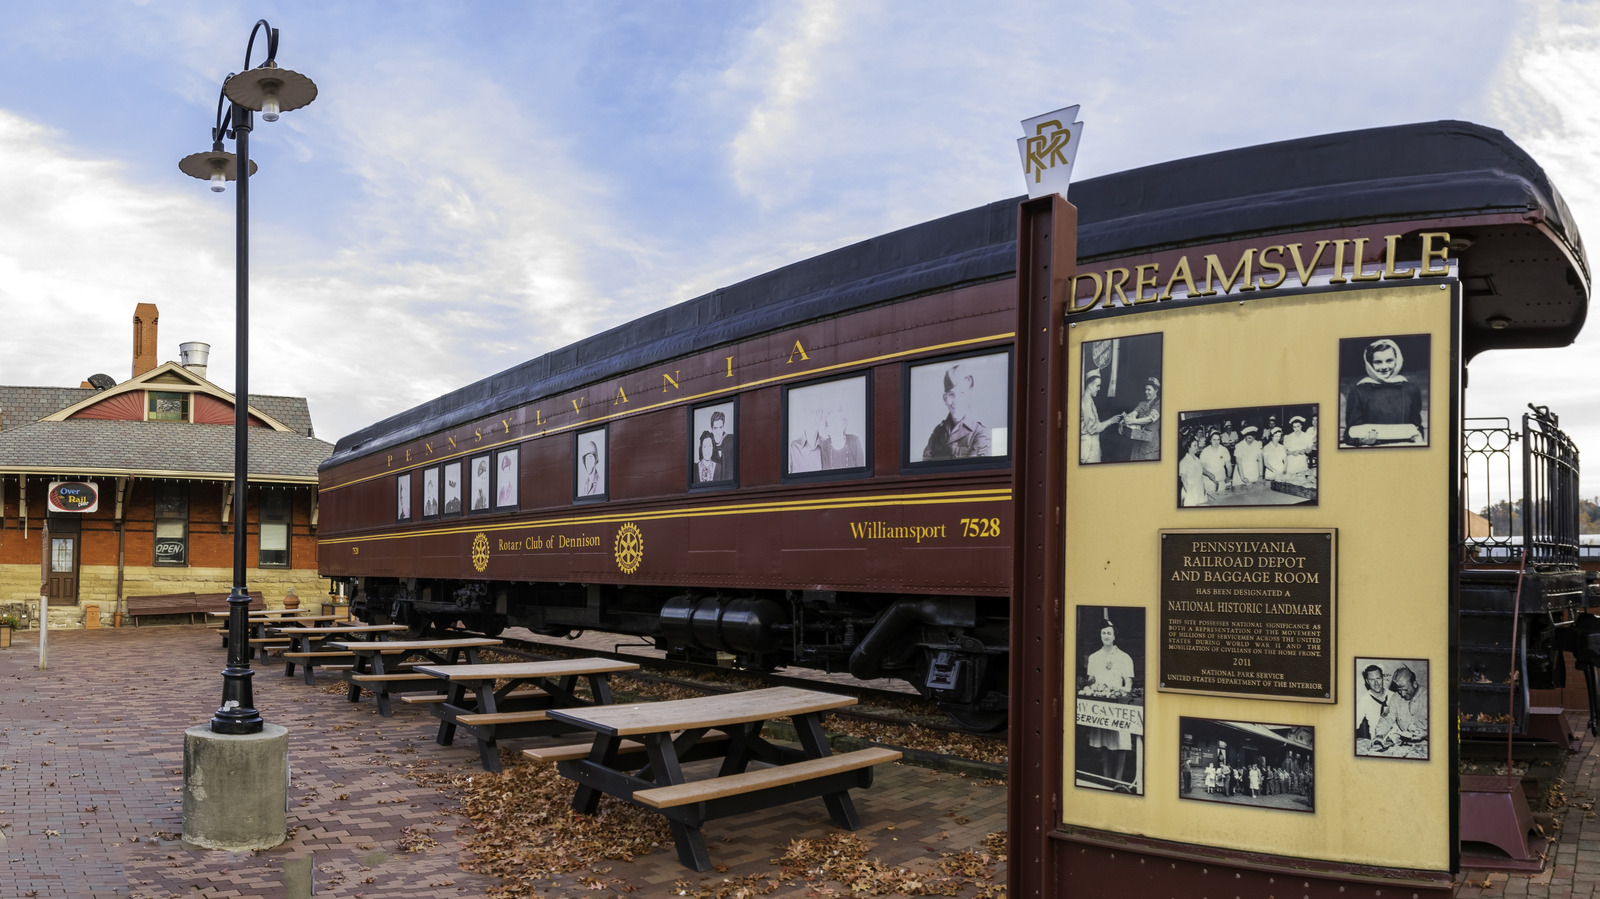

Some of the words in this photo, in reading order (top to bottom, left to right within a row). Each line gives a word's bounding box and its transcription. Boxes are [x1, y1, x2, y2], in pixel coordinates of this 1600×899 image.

[1066, 231, 1451, 314] DREAMSVILLE
[387, 339, 810, 467] PENNSYLVANIA
[60, 487, 80, 495] Over
[68, 495, 87, 503] Rail
[850, 521, 946, 543] Williamsport
[960, 518, 1001, 537] 7528
[498, 538, 522, 551] Rotary
[525, 535, 543, 550] Club
[545, 535, 555, 549] of
[559, 533, 600, 548] Dennison
[1192, 541, 1296, 553] PENNSYLVANIA
[156, 544, 180, 553] OPEN
[1184, 556, 1254, 568] RAILROAD
[1258, 556, 1306, 568] DEPOT
[1171, 570, 1200, 582] AND
[1204, 571, 1270, 583] BAGGAGE
[1274, 572, 1320, 584] ROOM
[1233, 589, 1283, 597] DESIGNATED
[1168, 600, 1215, 612] NATIONAL
[1217, 602, 1263, 614] HISTORIC
[1265, 603, 1322, 616] LANDMARK
[1195, 626, 1251, 634] REPRESENTATION
[1266, 622, 1310, 630] SIGNIFICANCE
[1168, 644, 1210, 652] MOBILIZATION
[1220, 646, 1251, 654] CIVILIANS
[1278, 649, 1297, 657] HOME
[1233, 658, 1251, 667] 2011
[1201, 669, 1236, 677] NATIONAL
[1256, 672, 1285, 680] SERVICE
[1167, 674, 1191, 682] UNITED
[1192, 675, 1216, 684] STATES
[1217, 677, 1261, 687] DEPARTMENT
[1273, 680, 1288, 688] THE
[1289, 682, 1323, 690] INTERIOR
[1076, 713, 1110, 727] SERVICE
[1111, 719, 1131, 729] MEN
